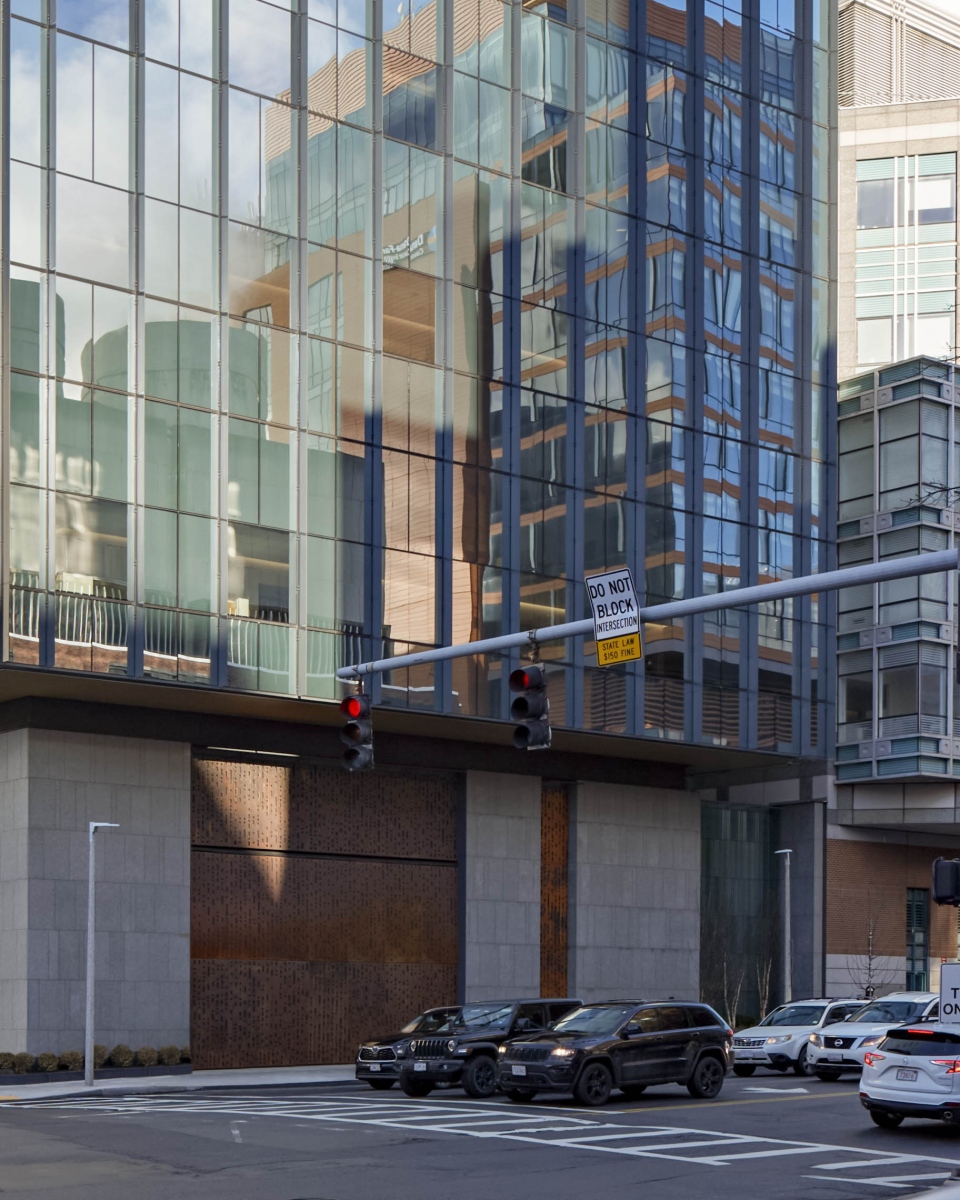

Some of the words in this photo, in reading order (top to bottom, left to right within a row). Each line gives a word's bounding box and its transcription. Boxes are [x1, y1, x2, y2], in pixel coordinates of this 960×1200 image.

[589, 583, 605, 599] DO
[608, 577, 631, 595] NOT
[597, 598, 634, 619] BLOCK
[596, 616, 638, 633] INTERSECTION
[602, 641, 619, 651] STATE
[622, 637, 635, 647] LAW
[603, 650, 618, 661] $150
[621, 647, 635, 657] FINE
